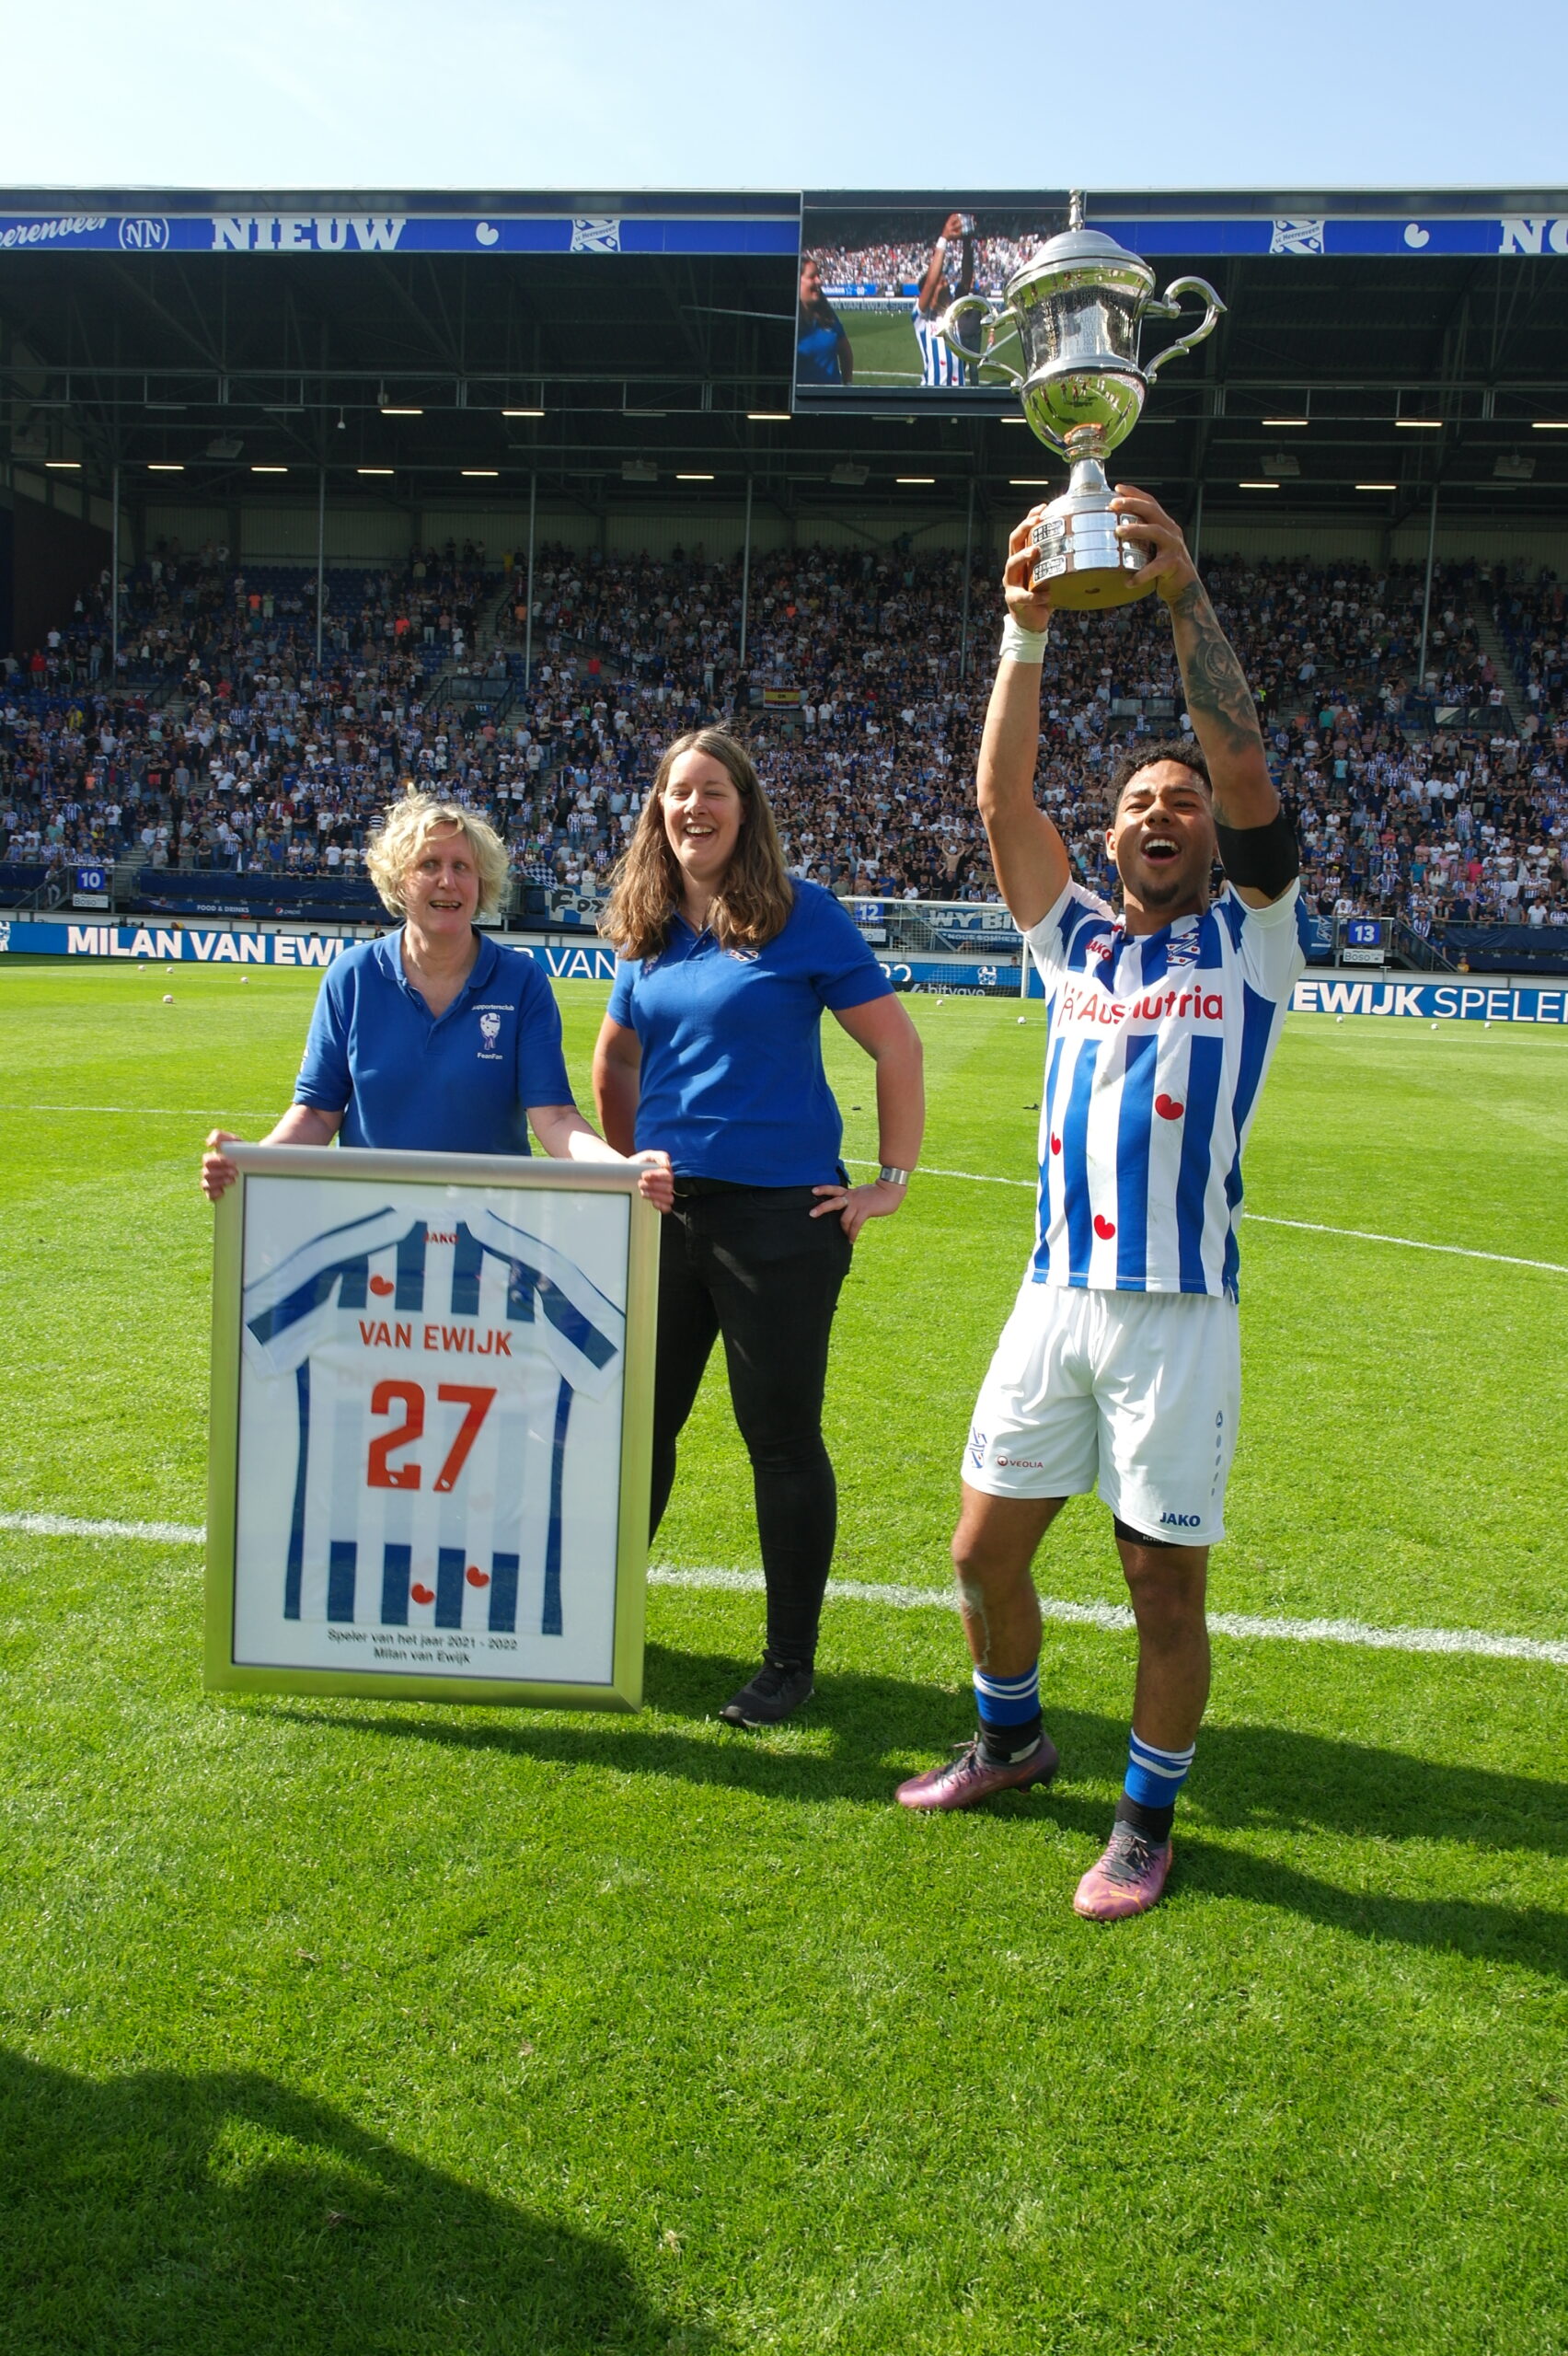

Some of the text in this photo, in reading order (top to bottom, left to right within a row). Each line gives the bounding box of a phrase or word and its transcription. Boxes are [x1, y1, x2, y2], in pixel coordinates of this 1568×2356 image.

[212, 218, 407, 250] NIEUW
[81, 872, 101, 888] 10
[859, 903, 879, 920] 12
[1355, 925, 1375, 942] 13
[67, 925, 372, 966] MILAN VAN EWI
[1086, 939, 1112, 960] JAKO
[545, 948, 618, 979] VAN
[928, 984, 986, 996] bitvavo
[1293, 981, 1568, 1022] EWIJK SPELE
[424, 1231, 458, 1244] JAKO
[359, 1320, 513, 1357] VAN EWIJK
[367, 1379, 497, 1493] 27
[1159, 1511, 1201, 1528] JAKO
[328, 1628, 368, 1644] Speler
[371, 1634, 394, 1645] van
[398, 1632, 417, 1646] het
[420, 1634, 444, 1648] jaar
[447, 1634, 476, 1648] 2021
[489, 1637, 518, 1651] 2022
[374, 1646, 471, 1666] Milan van Ewijk
